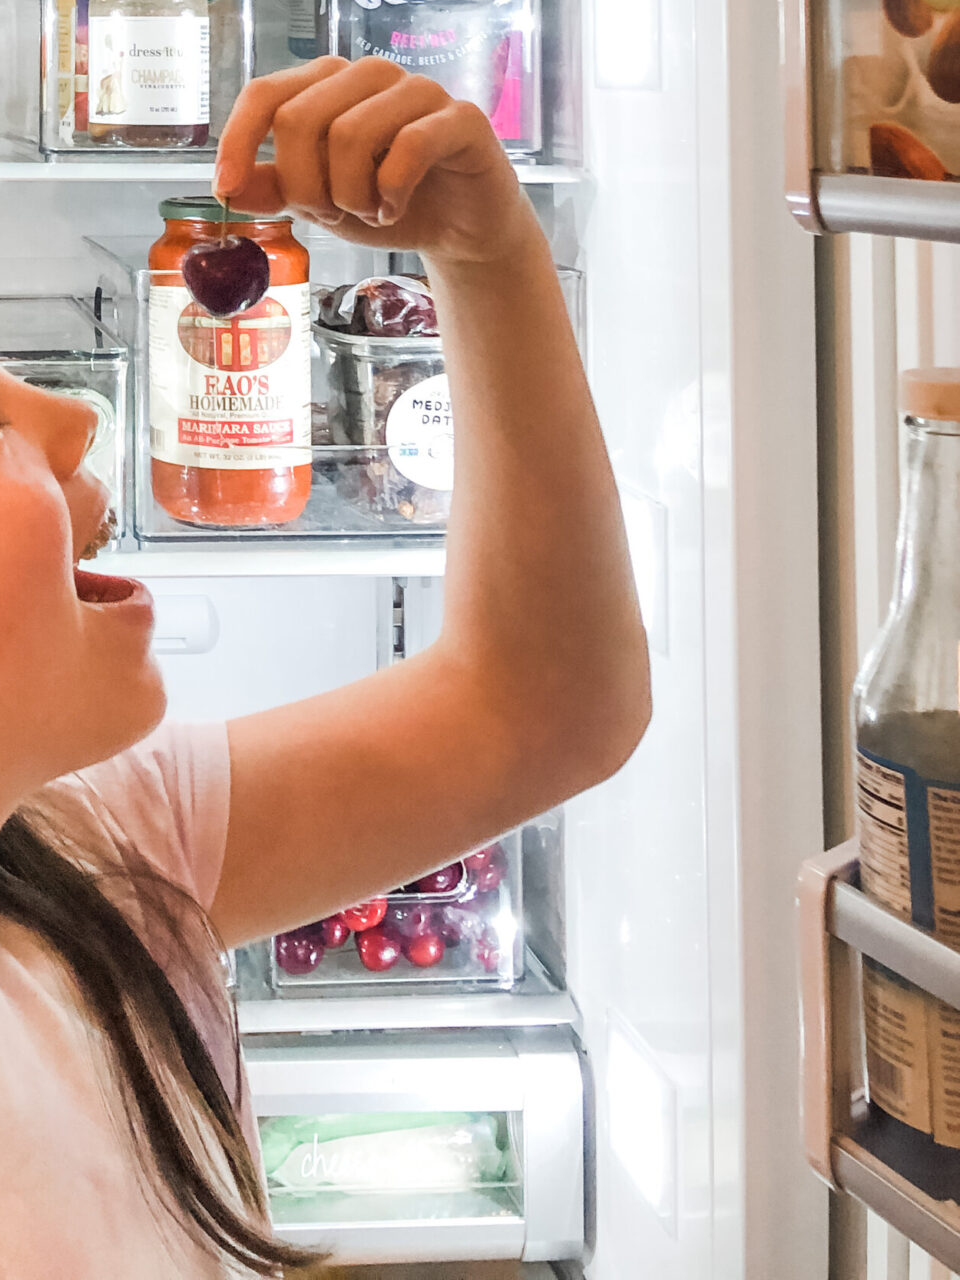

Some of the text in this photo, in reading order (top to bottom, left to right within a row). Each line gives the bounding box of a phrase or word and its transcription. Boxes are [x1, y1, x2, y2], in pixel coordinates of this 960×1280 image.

[390, 31, 426, 49] BEET
[428, 28, 457, 48] RED
[129, 43, 184, 58] dress it u
[418, 53, 447, 66] BEETS
[204, 374, 269, 396] RAO'S
[182, 421, 249, 434] MARINARA
[421, 414, 451, 426] DAT
[301, 1132, 356, 1178] che
